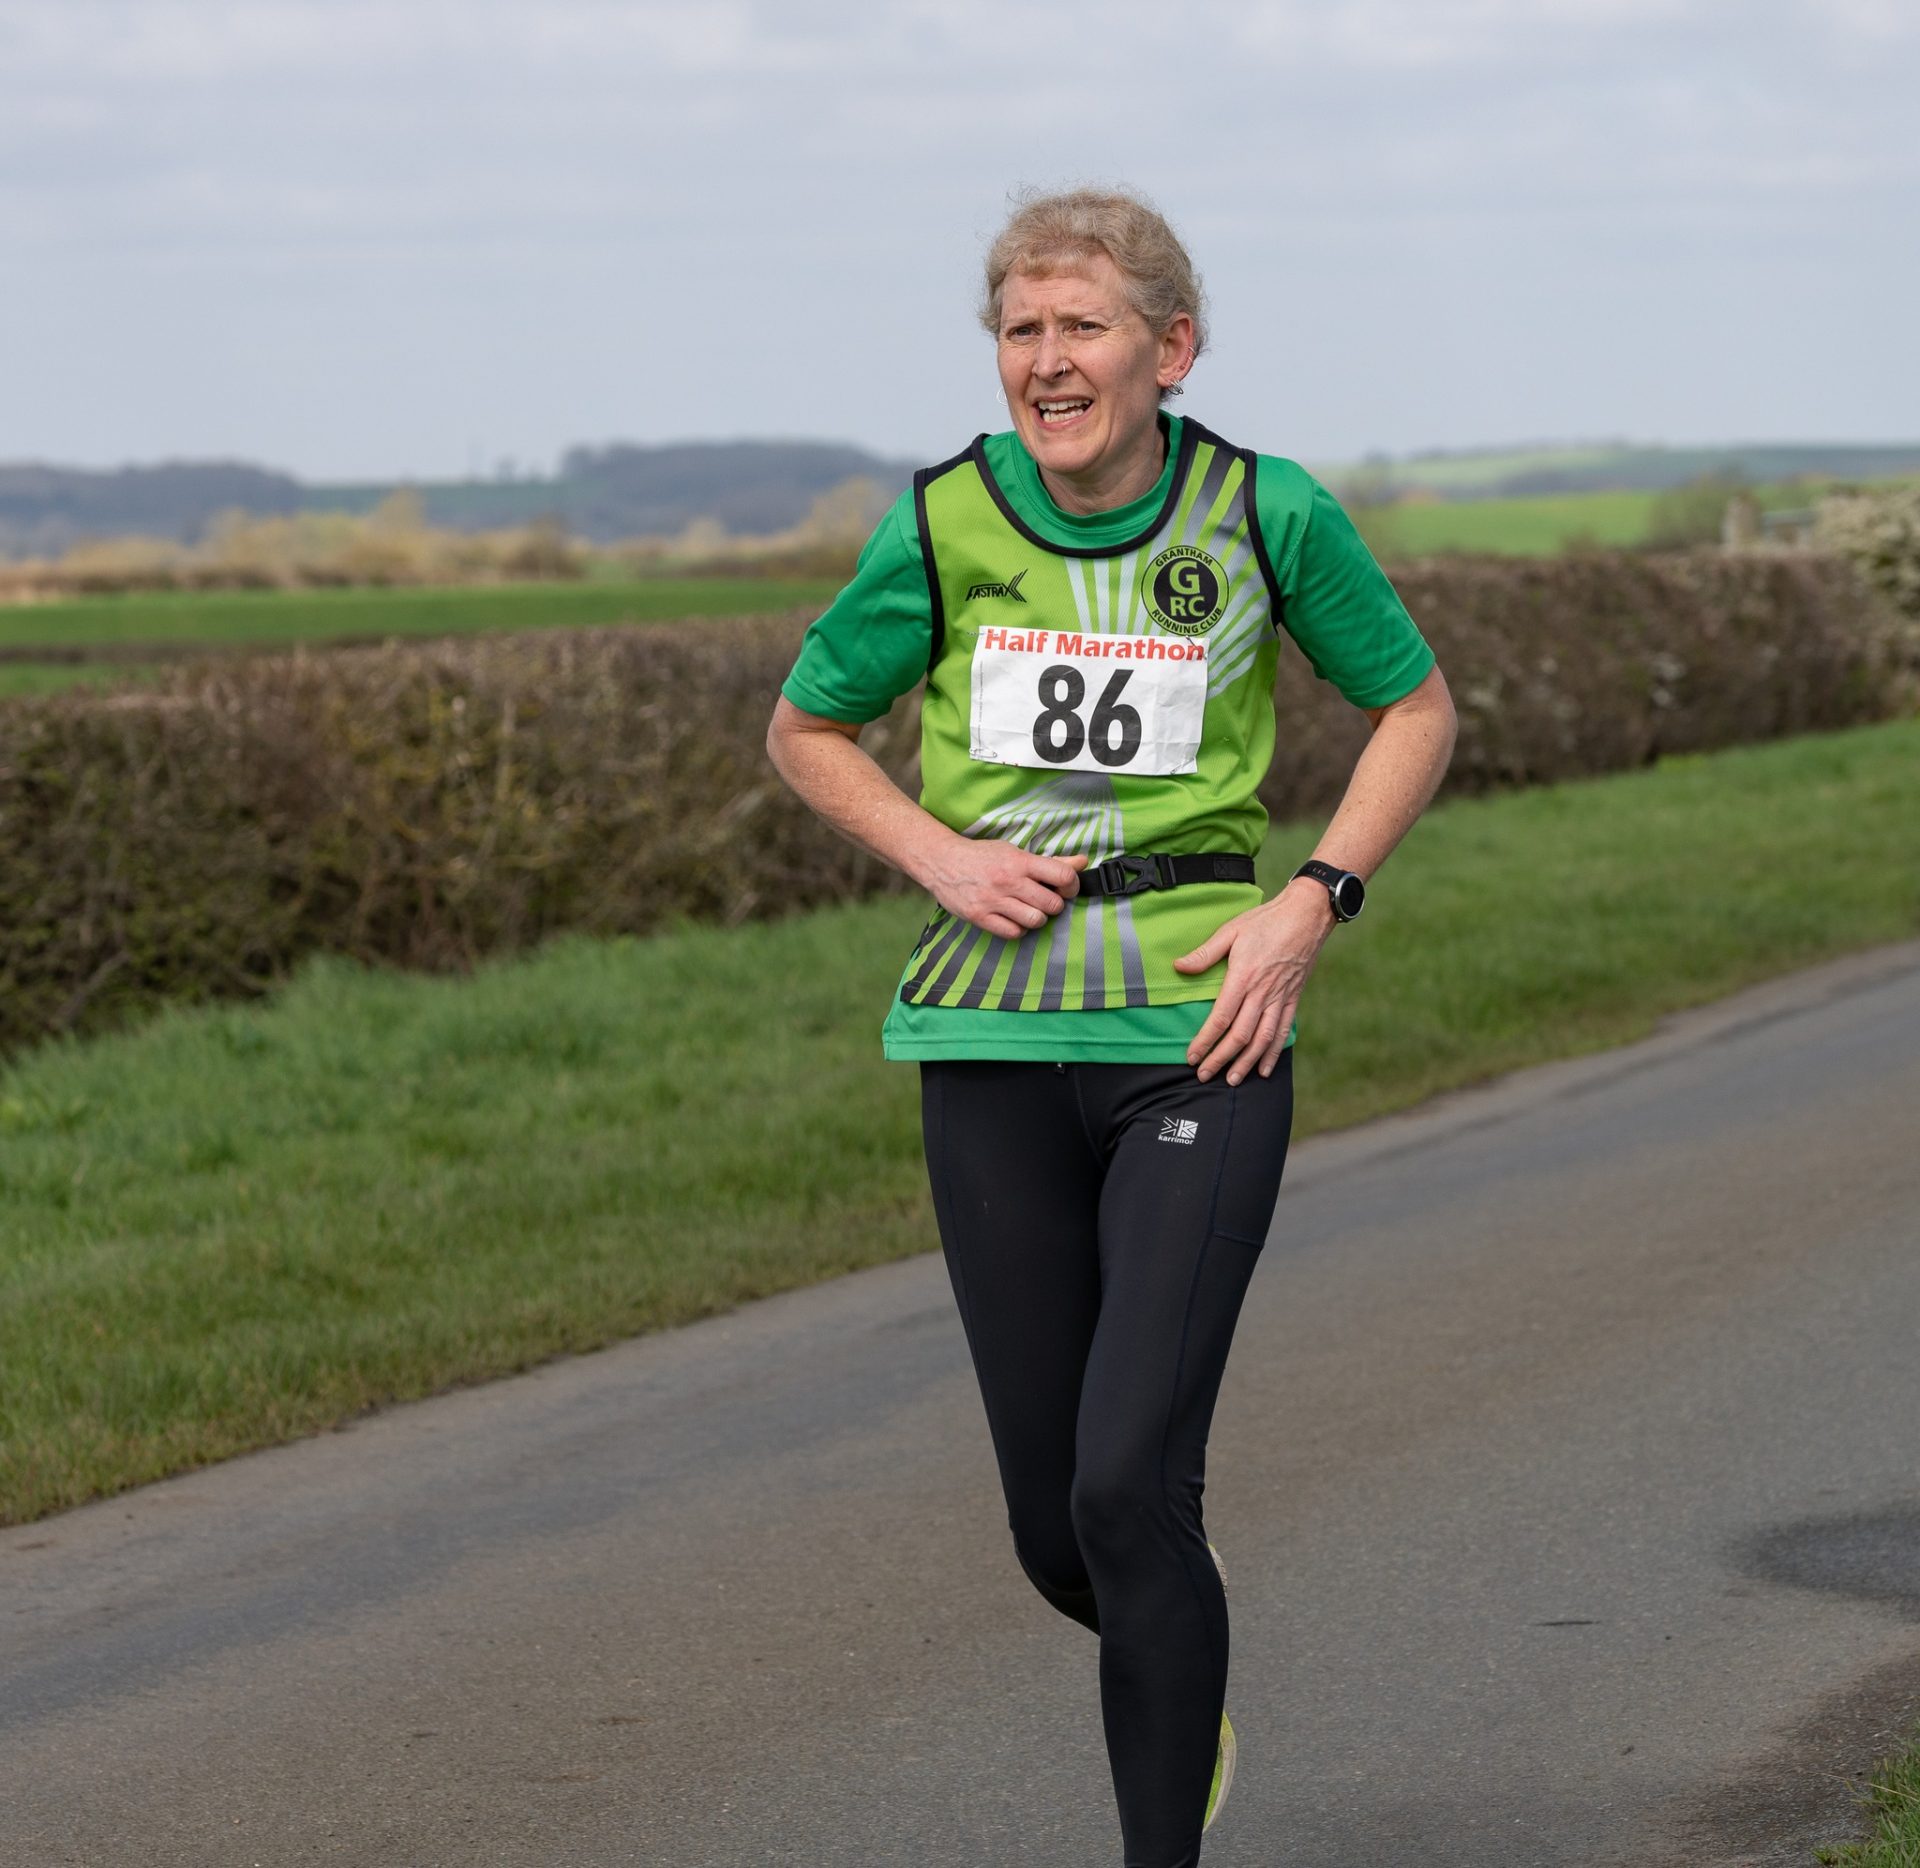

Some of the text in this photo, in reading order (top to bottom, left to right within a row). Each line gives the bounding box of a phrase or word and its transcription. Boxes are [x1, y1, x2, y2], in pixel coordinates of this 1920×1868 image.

[1155, 548, 1213, 567] GRANTHAM
[1169, 560, 1200, 595] G
[1170, 596, 1206, 617] RC
[1152, 608, 1222, 634] RUNNING CLUB
[984, 628, 1206, 662] Half Marathon
[1032, 664, 1142, 767] 86
[1158, 1134, 1194, 1145] karrimor
